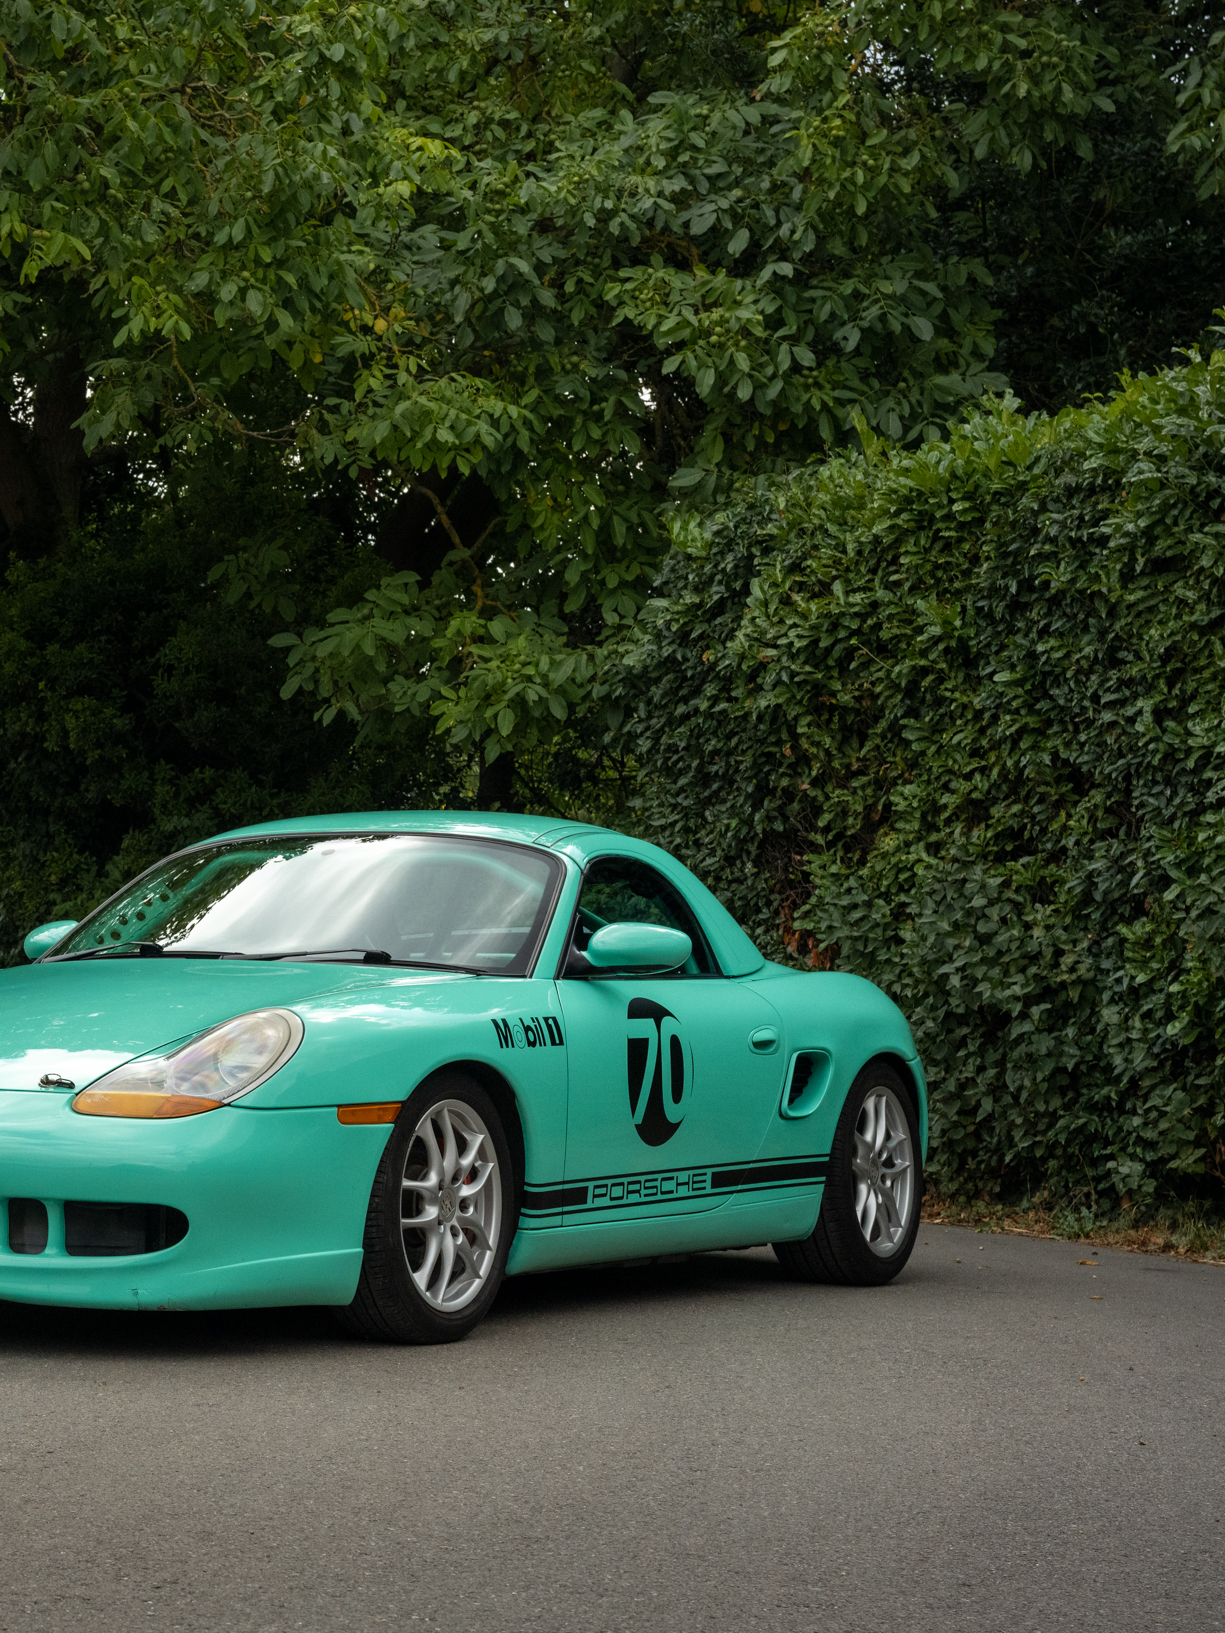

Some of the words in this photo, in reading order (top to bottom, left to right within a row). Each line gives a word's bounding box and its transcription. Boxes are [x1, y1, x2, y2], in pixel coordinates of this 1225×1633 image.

[490, 1016, 547, 1049] Mobil
[545, 1017, 562, 1045] 1
[627, 1016, 694, 1124] 70
[592, 1172, 707, 1204] PORSCHE
